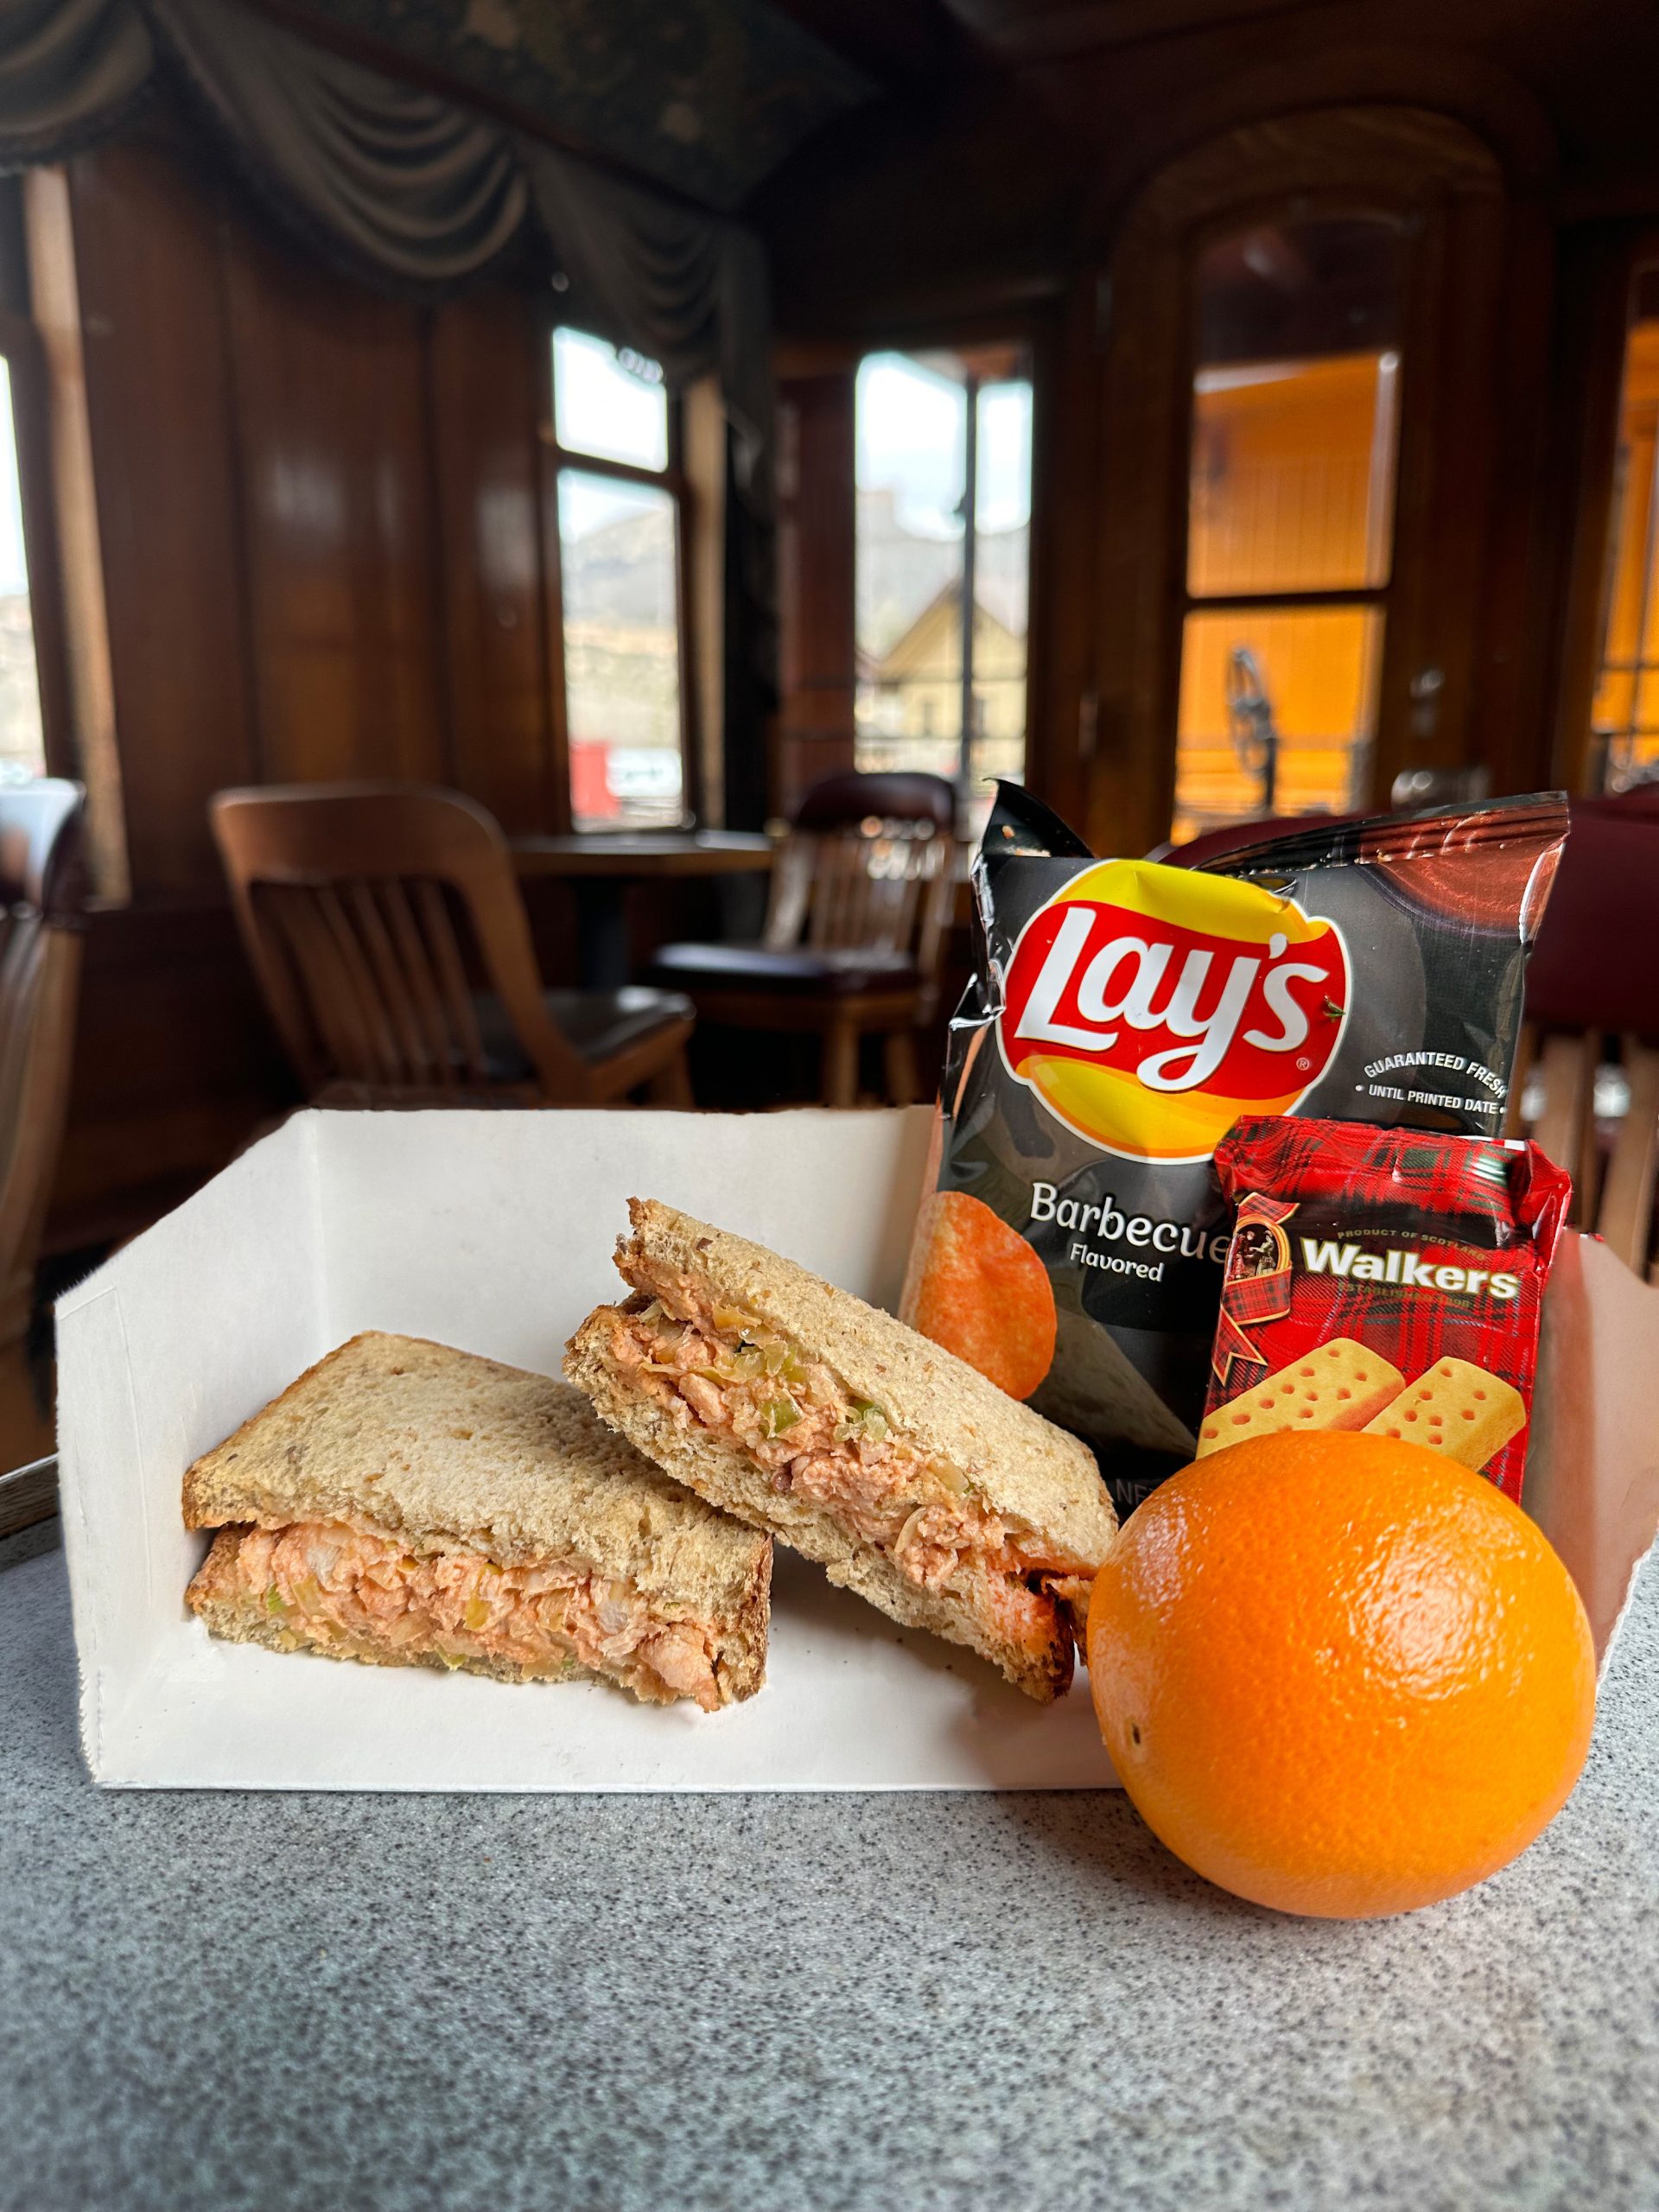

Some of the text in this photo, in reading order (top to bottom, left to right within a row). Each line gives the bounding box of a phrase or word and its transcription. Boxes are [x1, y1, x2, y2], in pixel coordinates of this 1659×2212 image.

[1014, 906, 1329, 1092] Lay's
[1363, 1052, 1509, 1099] GUARANTEED FRESH
[1368, 1084, 1501, 1115] UNTIL PRINTED DATE
[1030, 1181, 1230, 1264] Barbecue
[1337, 1228, 1485, 1262] PRODUCT OF SCOTLAND
[1070, 1243, 1165, 1282] Flavored
[1299, 1236, 1520, 1300] Walkers
